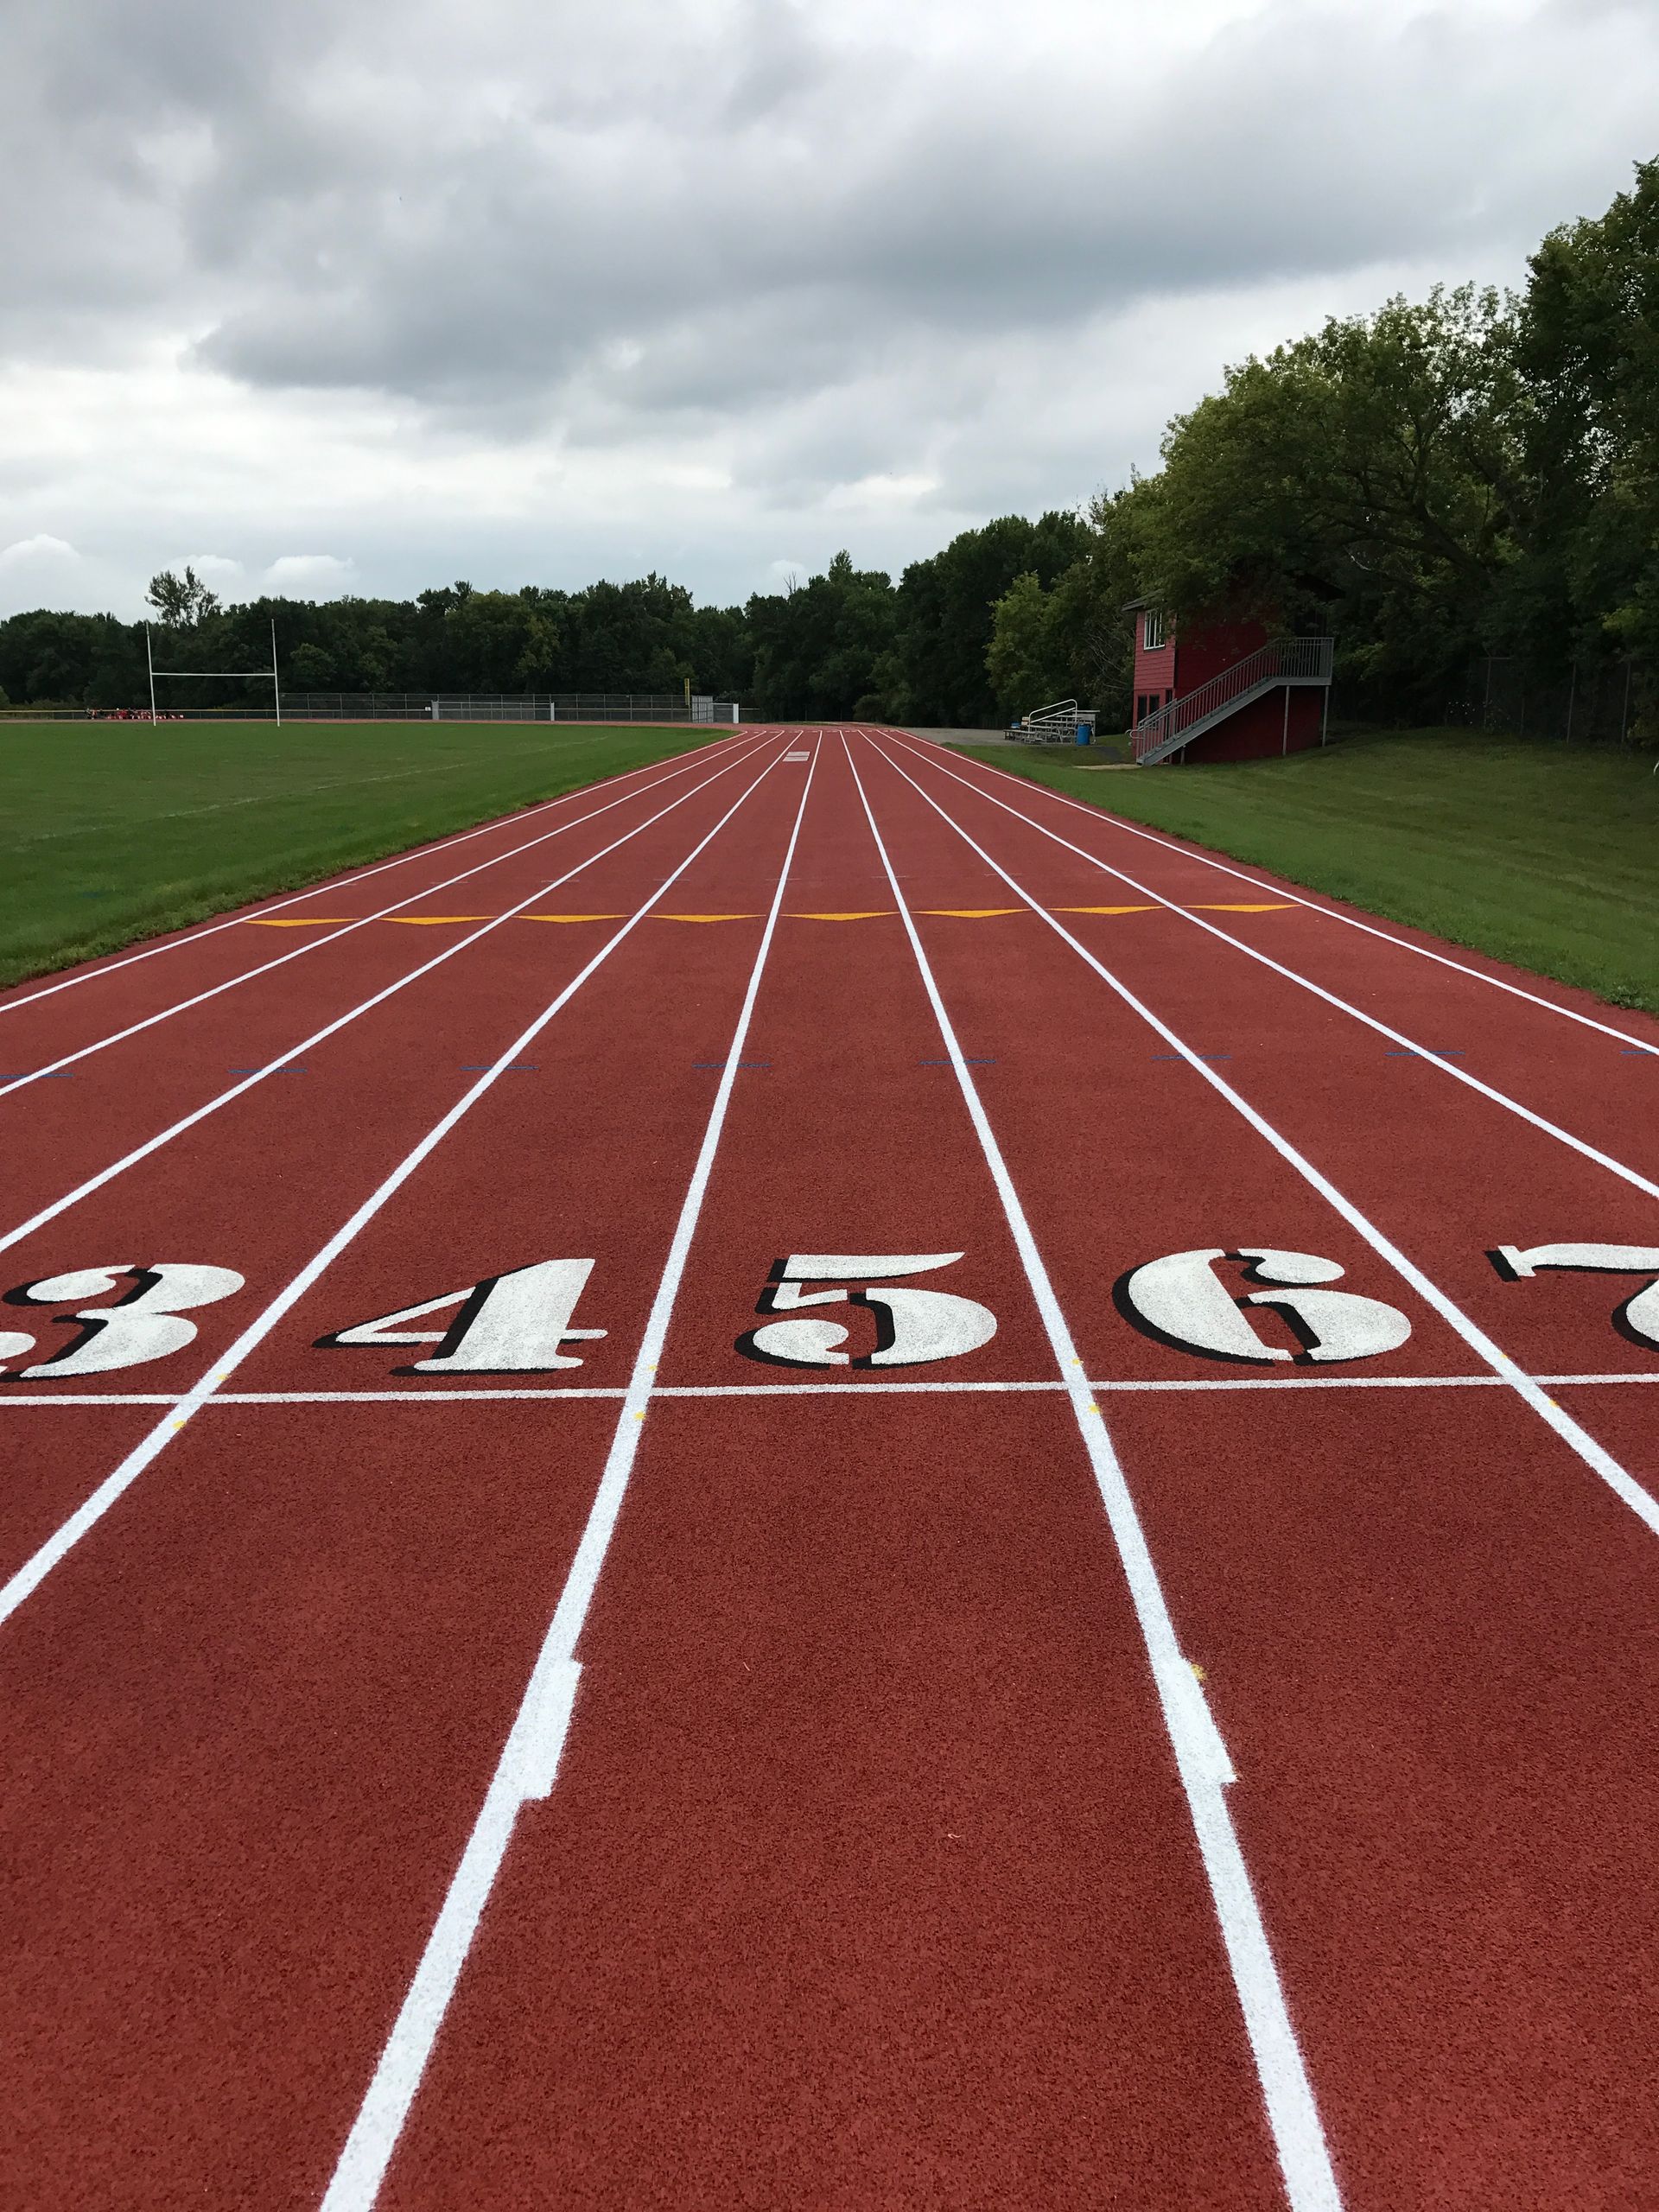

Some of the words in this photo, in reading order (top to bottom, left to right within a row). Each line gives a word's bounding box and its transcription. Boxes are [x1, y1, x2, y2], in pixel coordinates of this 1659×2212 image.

[0, 1263, 245, 1382] 3
[313, 1258, 608, 1376] 4
[734, 1251, 999, 1370] 5
[1112, 1249, 1412, 1367] 6
